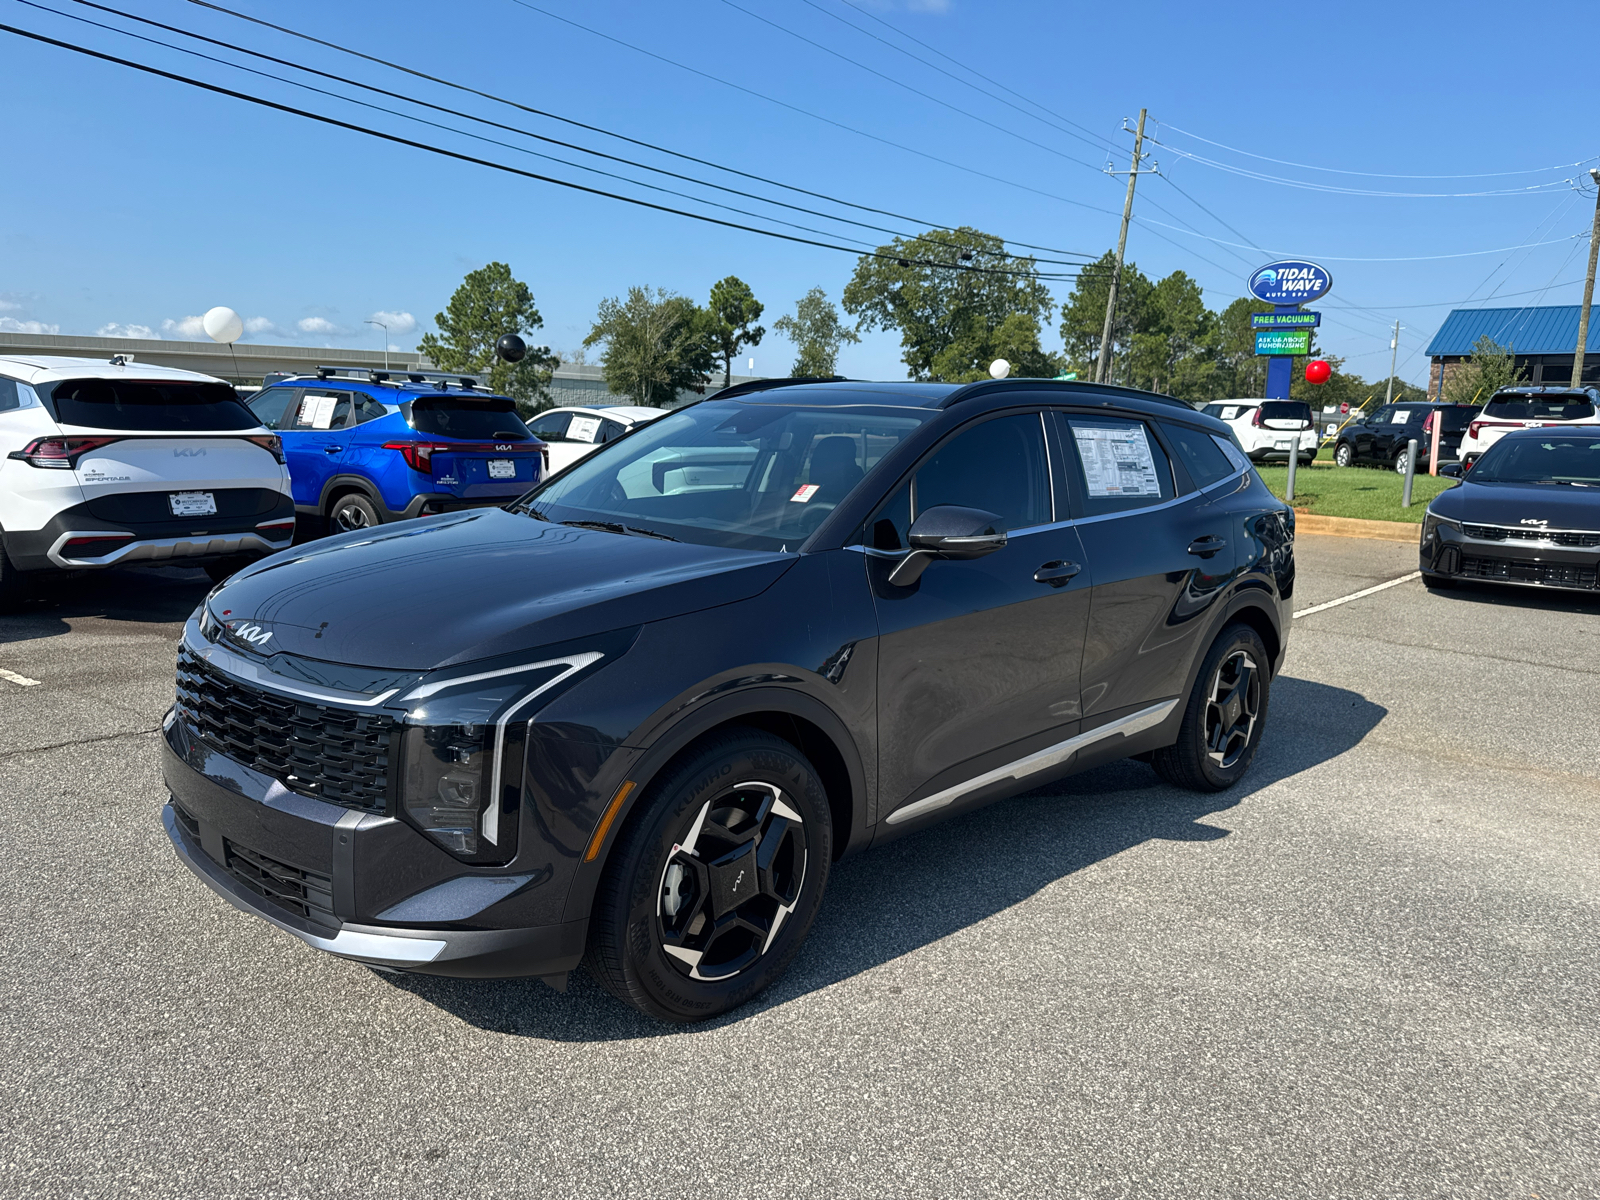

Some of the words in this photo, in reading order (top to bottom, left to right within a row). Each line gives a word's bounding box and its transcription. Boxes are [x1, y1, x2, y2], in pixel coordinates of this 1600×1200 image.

[1277, 268, 1315, 279] TIDAL
[1282, 280, 1323, 291] WAVE
[1254, 316, 1274, 324] FREE
[1277, 315, 1315, 323] VACUUMS
[173, 448, 207, 457] KIA
[235, 622, 273, 645] KIA
[673, 764, 732, 818] KUMHO
[649, 969, 666, 991] 103H
[665, 989, 682, 1003] R18
[682, 998, 712, 1010] 235/60
